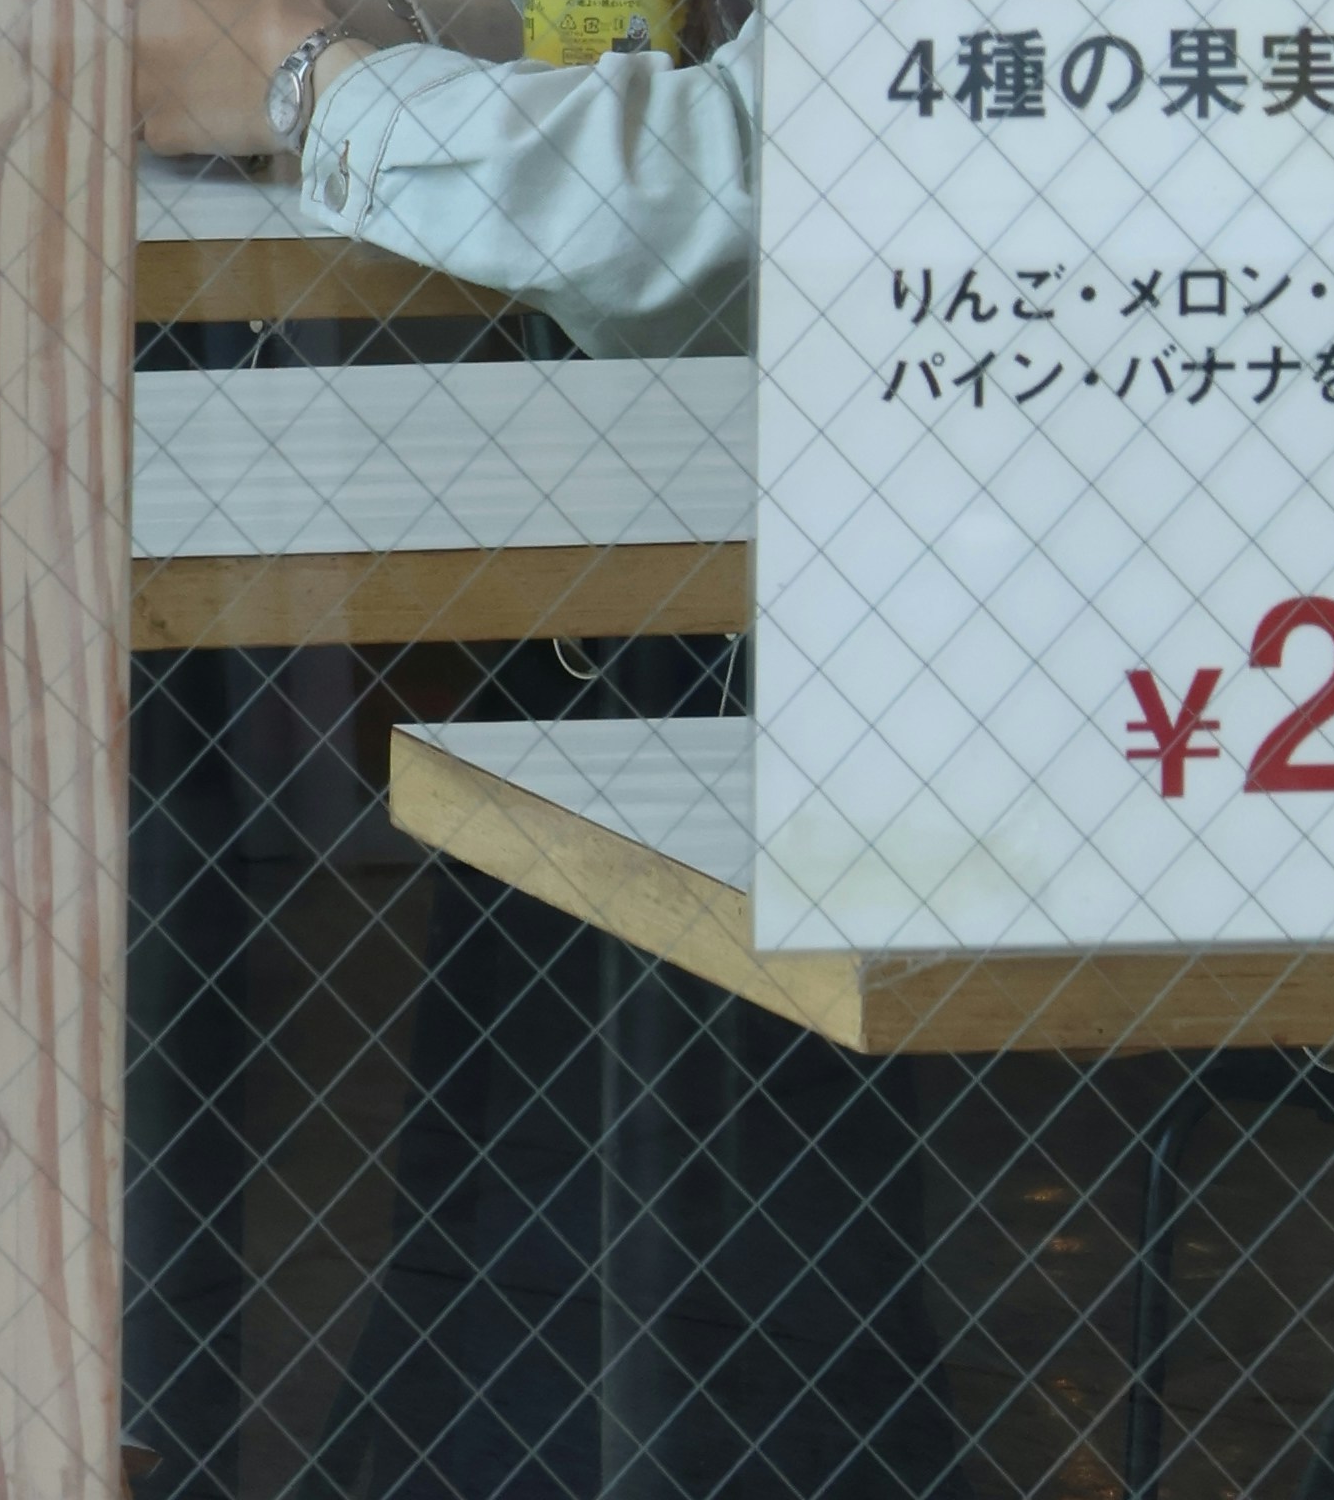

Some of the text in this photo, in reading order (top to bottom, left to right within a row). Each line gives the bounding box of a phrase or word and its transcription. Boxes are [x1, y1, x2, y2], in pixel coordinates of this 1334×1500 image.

[886, 264, 1329, 328] りんご・メロン・
